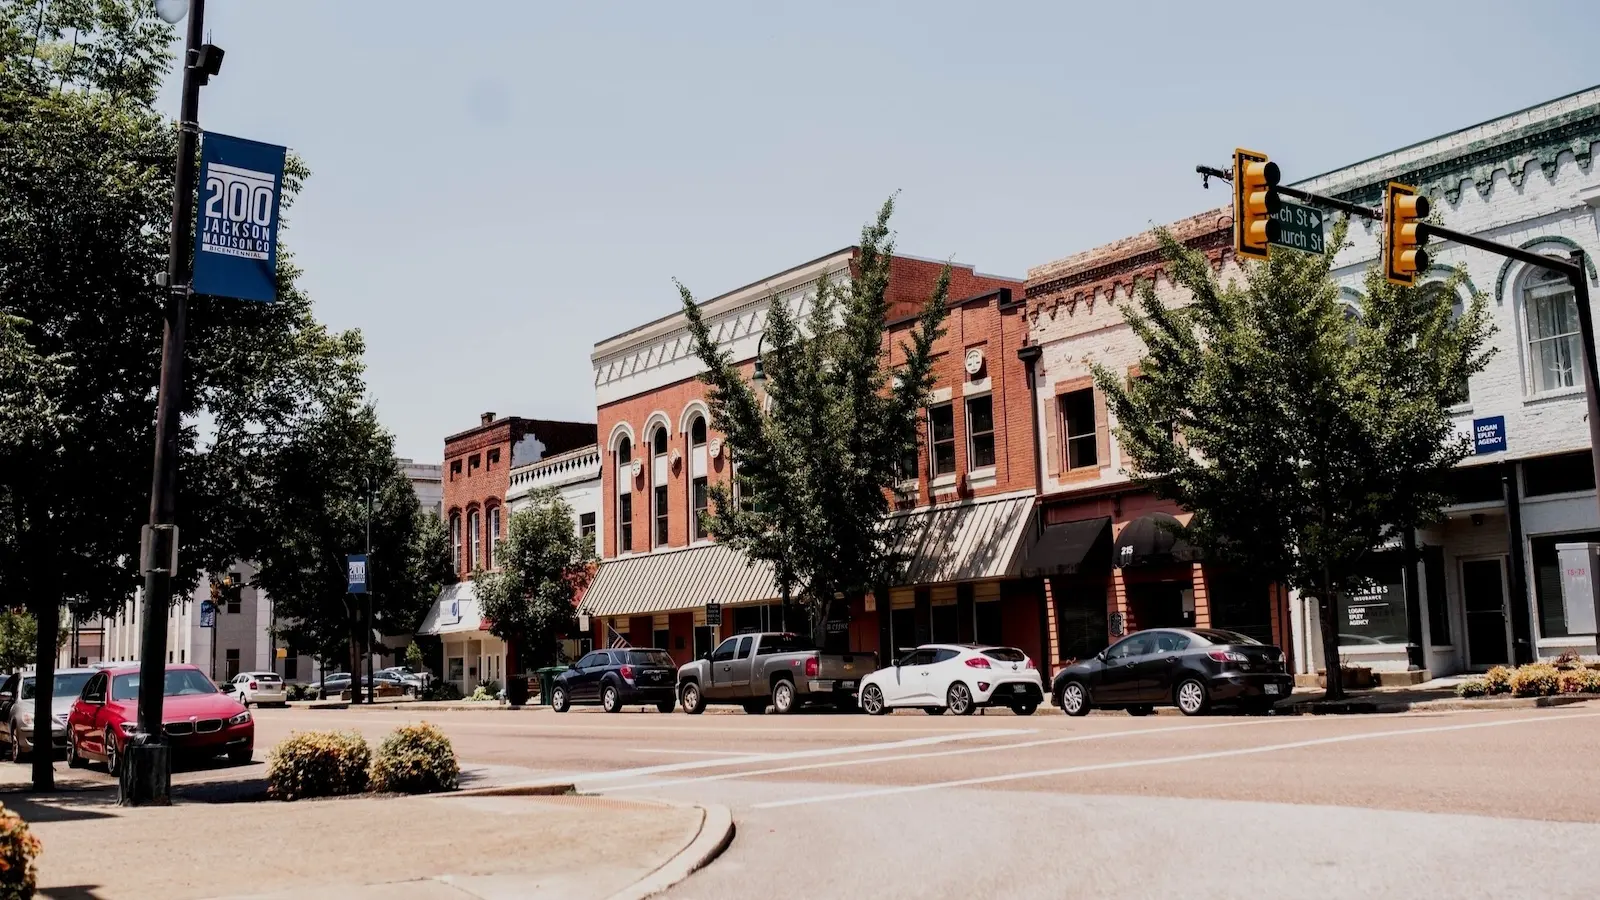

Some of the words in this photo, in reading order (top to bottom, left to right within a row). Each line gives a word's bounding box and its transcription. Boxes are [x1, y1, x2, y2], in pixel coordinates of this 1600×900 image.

[205, 177, 273, 226] 200
[1296, 208, 1308, 227] St
[203, 217, 270, 241] JACKSON
[202, 232, 253, 250] MADISON
[256, 240, 270, 252] CO
[1310, 232, 1322, 251] St
[209, 246, 262, 259] BICENTENNIAL
[1477, 424, 1497, 432] LOGAN
[1478, 437, 1502, 445] AGENCY
[1121, 545, 1134, 555] 215
